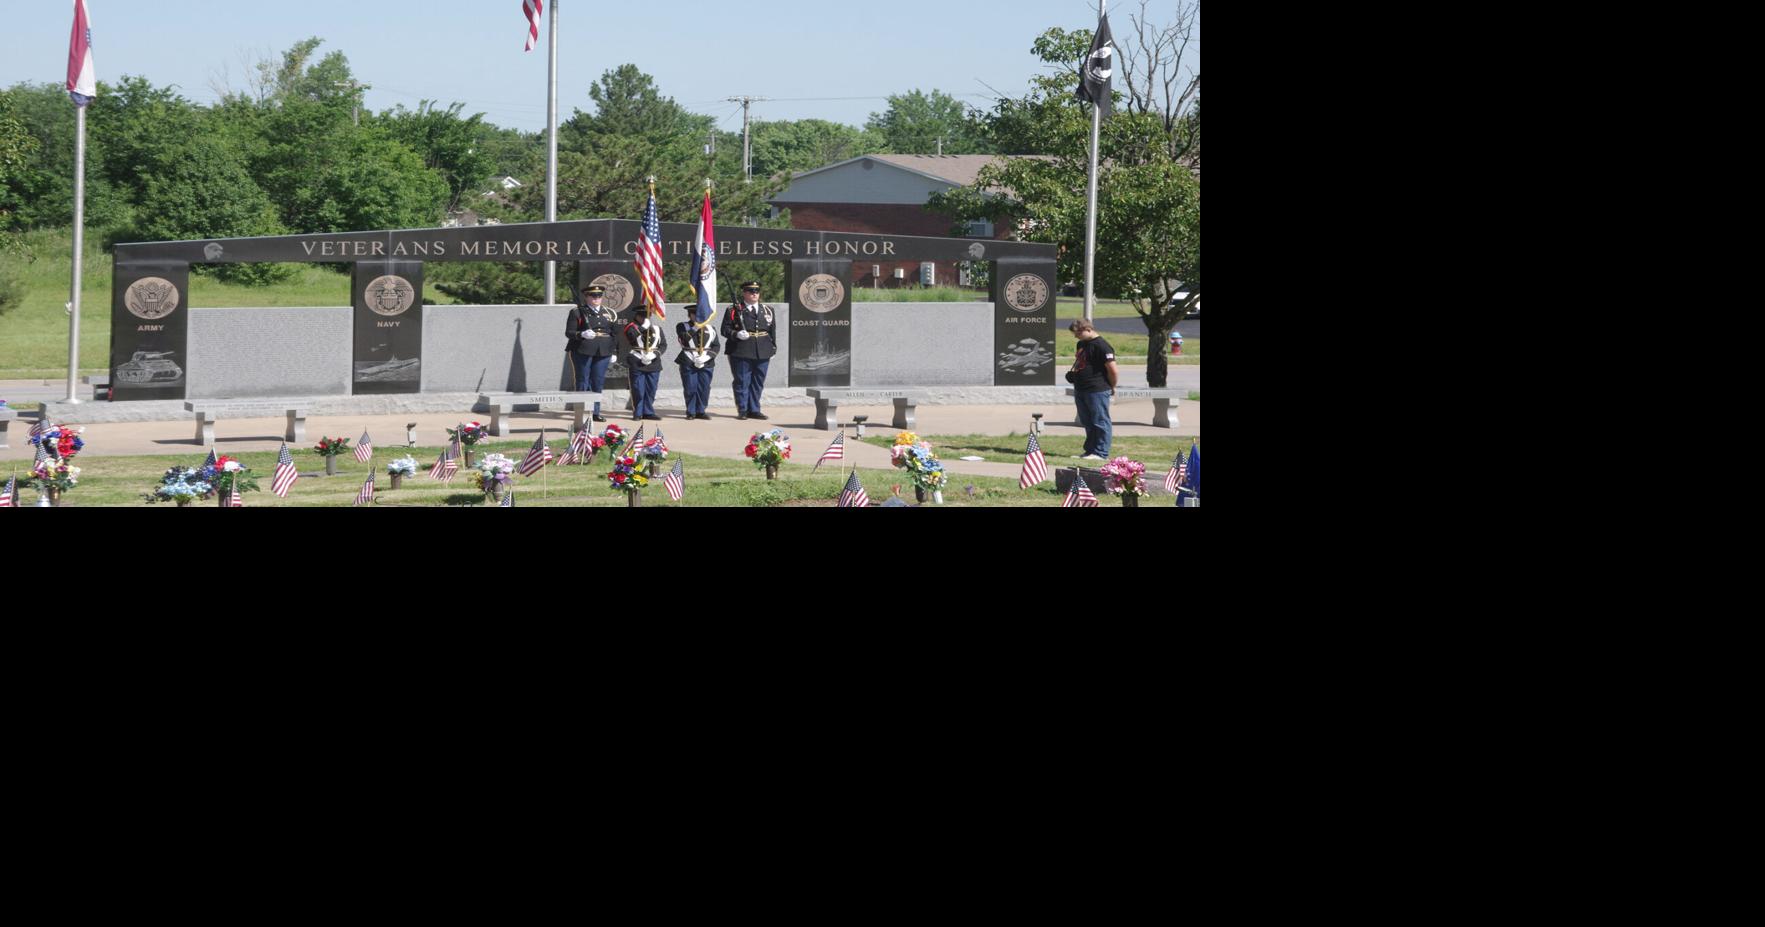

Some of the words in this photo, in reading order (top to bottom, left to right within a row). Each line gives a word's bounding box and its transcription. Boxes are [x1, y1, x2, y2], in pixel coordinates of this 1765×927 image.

[301, 240, 445, 256] VETERANS
[460, 240, 610, 256] MEMORIAL
[668, 240, 793, 255] TIELESS
[806, 240, 896, 255] HONOR
[137, 324, 165, 332] ARMY
